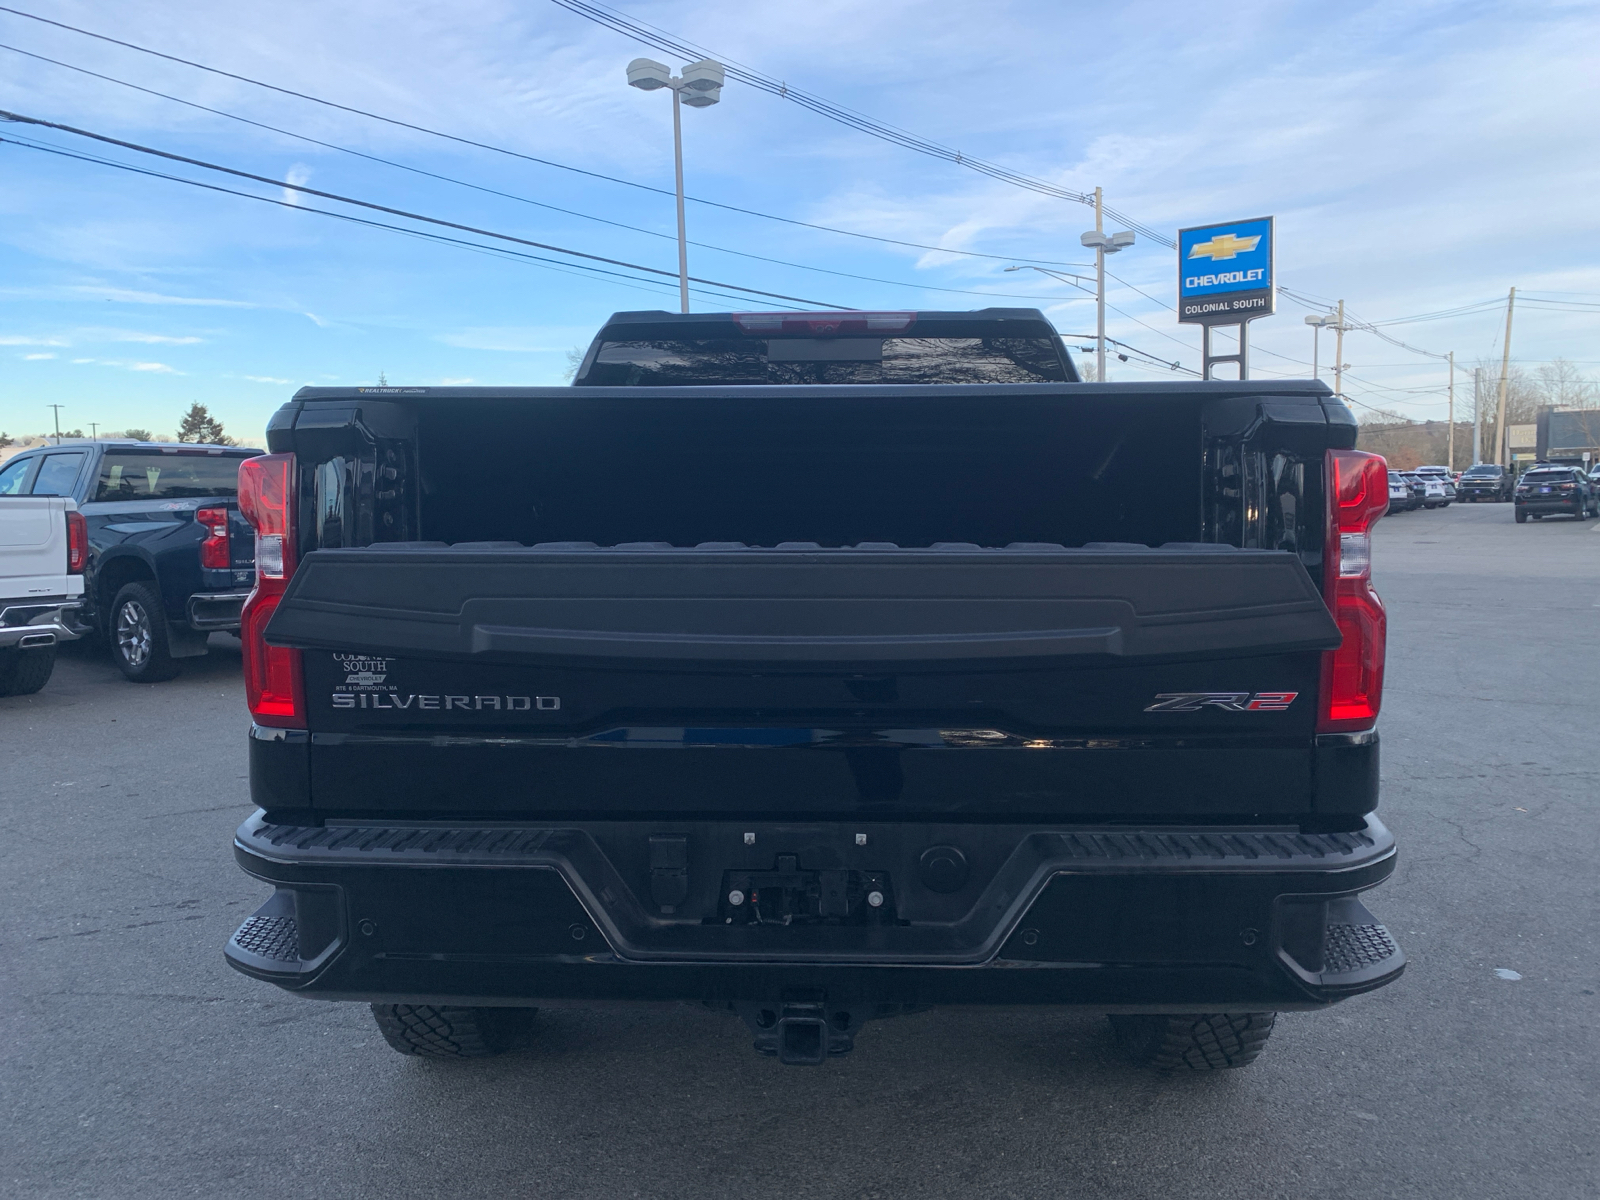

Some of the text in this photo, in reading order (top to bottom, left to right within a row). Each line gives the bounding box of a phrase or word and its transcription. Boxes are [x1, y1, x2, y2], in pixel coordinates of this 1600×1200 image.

[1185, 268, 1265, 288] CHEVROLET
[1185, 298, 1265, 314] COLONIAL SOUTH
[343, 661, 387, 671] SOUTH
[332, 693, 561, 710] SILVERADO
[1143, 692, 1299, 711] ZR2
